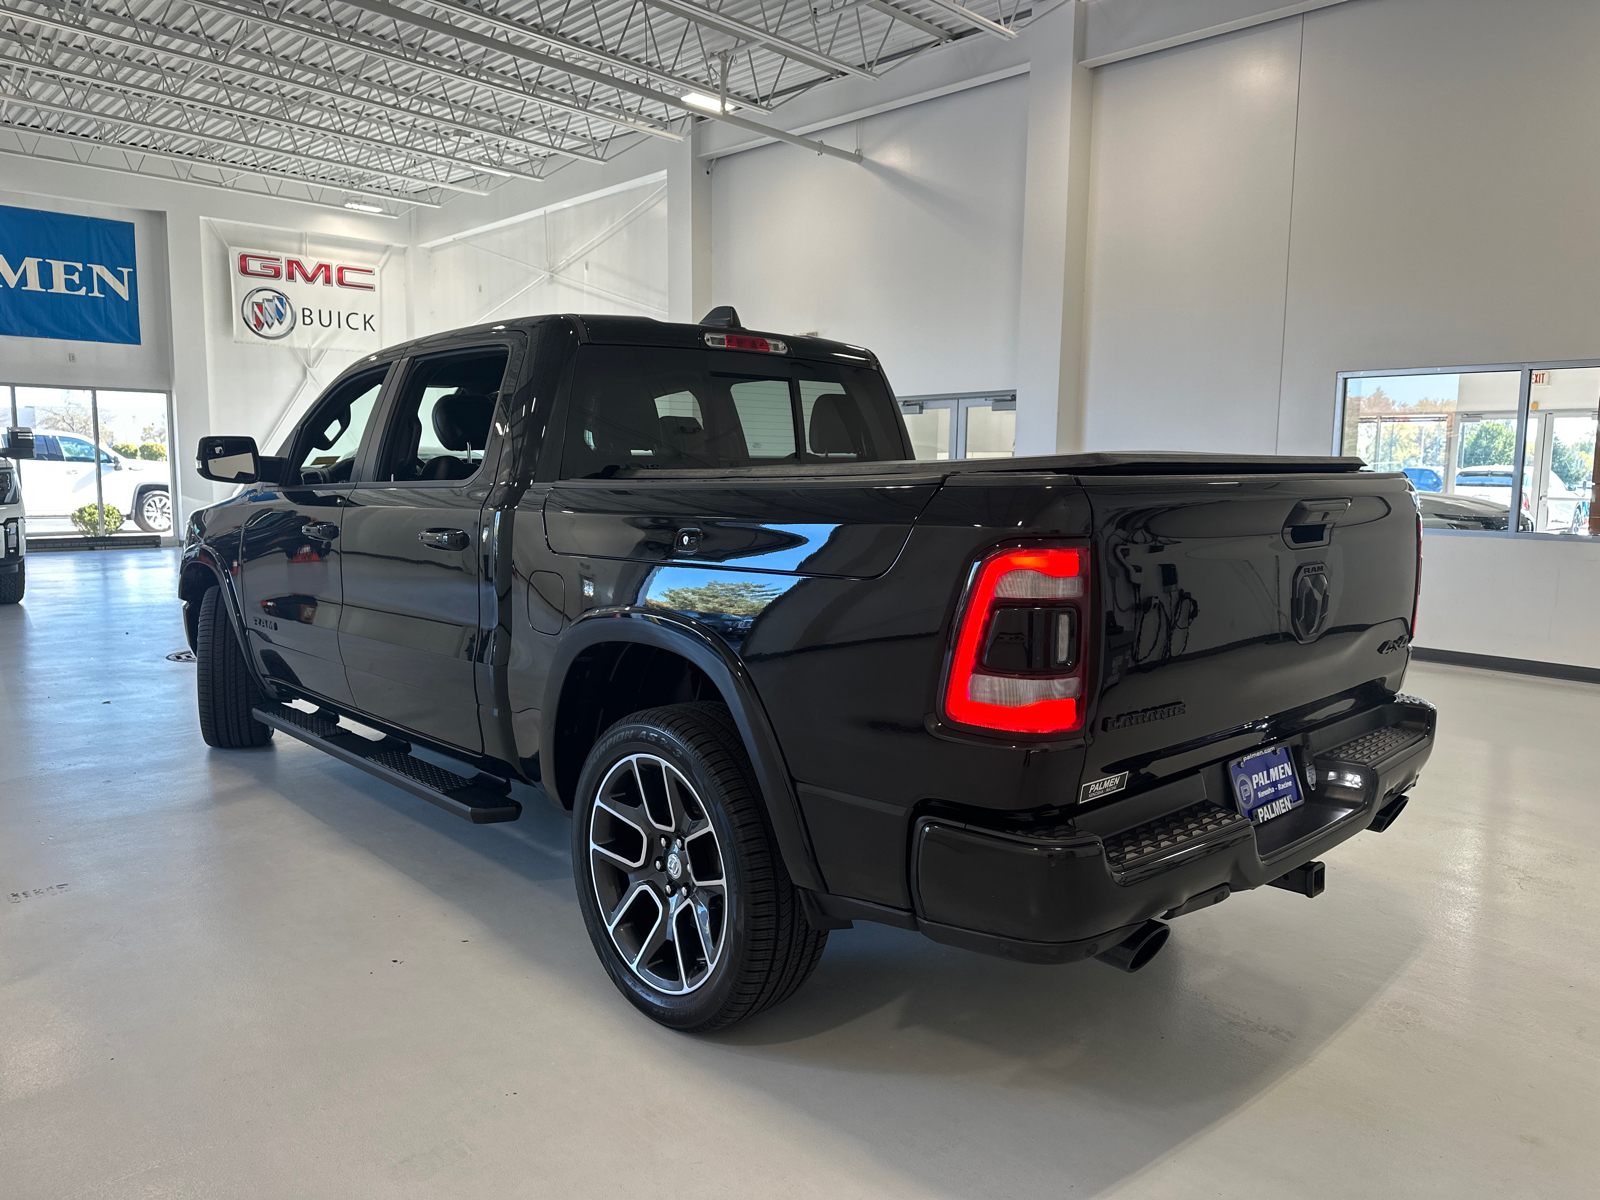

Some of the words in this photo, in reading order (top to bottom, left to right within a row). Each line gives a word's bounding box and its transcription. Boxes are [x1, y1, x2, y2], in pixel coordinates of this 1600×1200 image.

[0, 255, 133, 301] MEN
[238, 251, 375, 292] GMC
[301, 307, 375, 332] BUICK
[1303, 565, 1324, 574] RAM
[1102, 702, 1186, 732] LARAMIE
[1243, 746, 1275, 763] palmen.com
[1088, 776, 1121, 793] PALMEN
[1251, 762, 1293, 789] PALMEN
[1257, 796, 1292, 824] PALMEN
